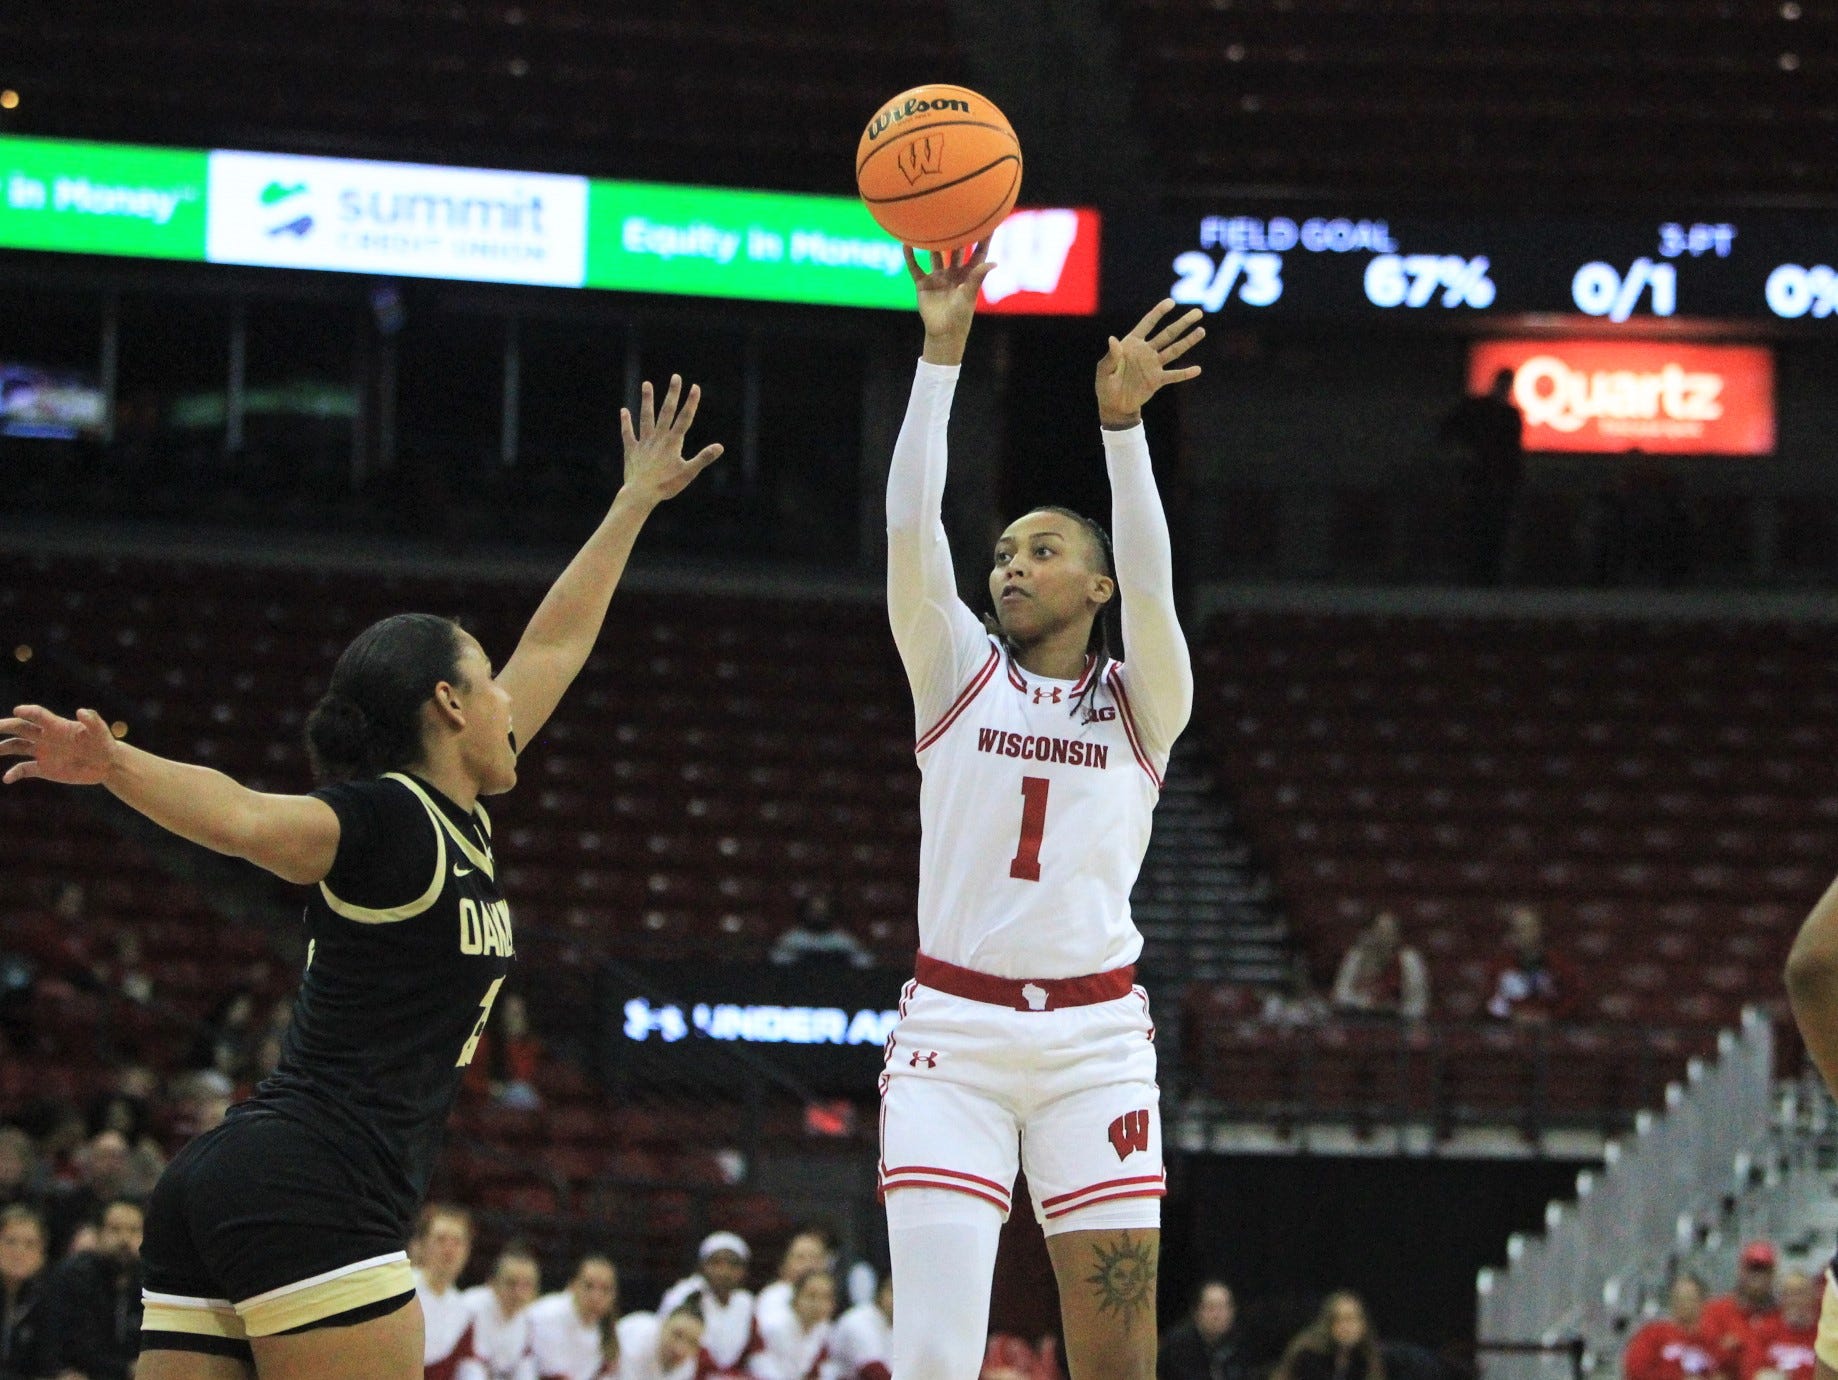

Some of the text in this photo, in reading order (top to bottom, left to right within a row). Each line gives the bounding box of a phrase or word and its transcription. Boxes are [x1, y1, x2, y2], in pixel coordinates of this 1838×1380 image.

[867, 98, 970, 141] Wilson
[338, 184, 546, 235] summit
[1200, 216, 1400, 253] FIELD GOAL
[748, 225, 785, 262] in
[1171, 250, 1283, 313] 2/3
[1363, 253, 1497, 309] 67%
[1571, 256, 1677, 323] 0/1
[1514, 355, 1724, 433] Quartz
[978, 727, 1109, 770] WISCONSIN
[1009, 776, 1050, 882] 1
[692, 1002, 849, 1045] UNDER
